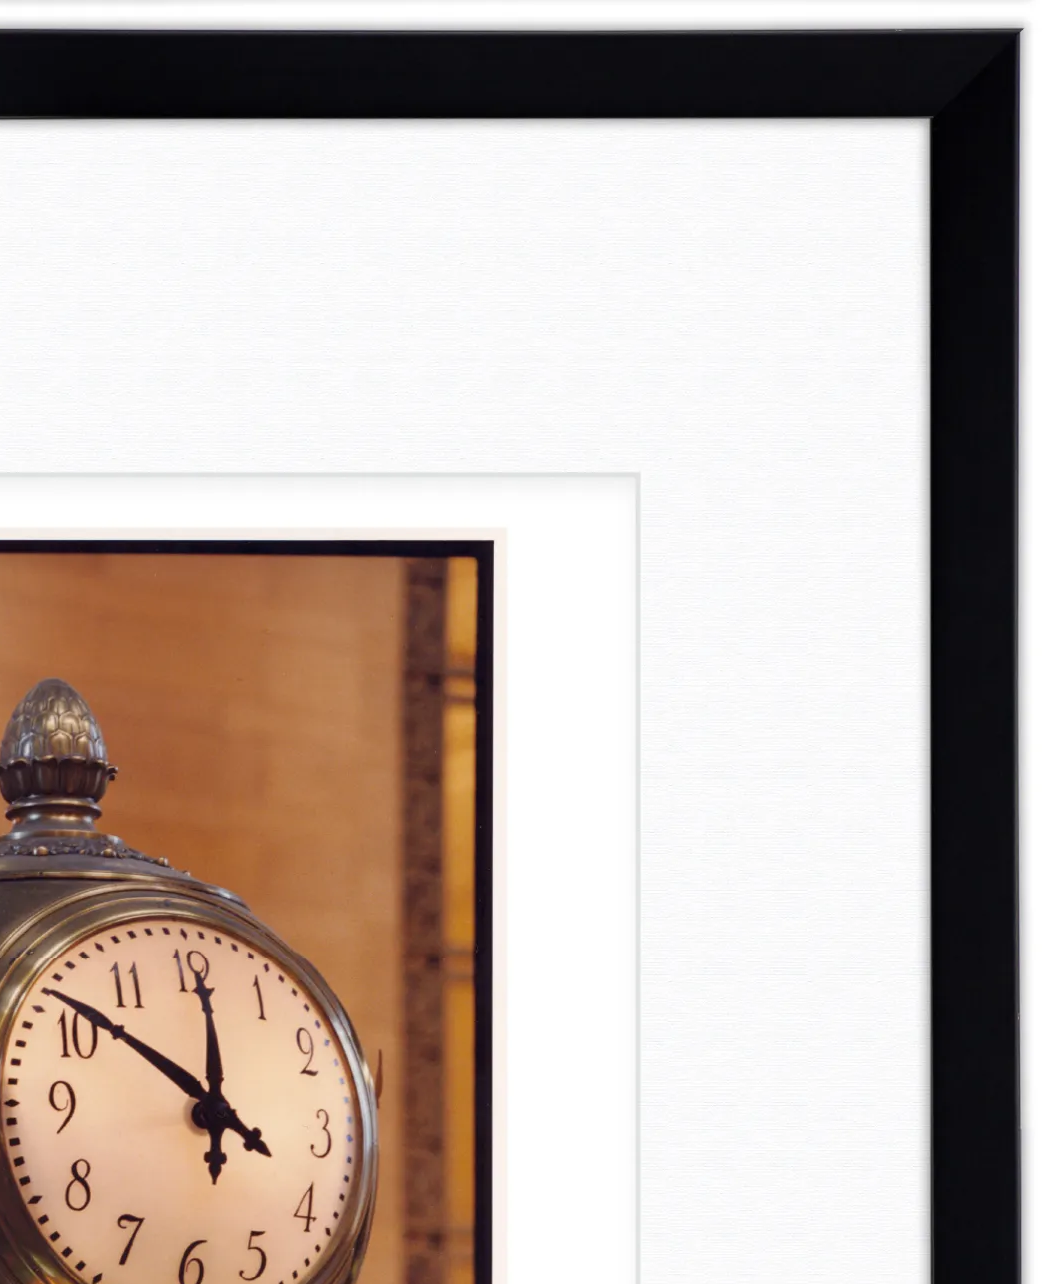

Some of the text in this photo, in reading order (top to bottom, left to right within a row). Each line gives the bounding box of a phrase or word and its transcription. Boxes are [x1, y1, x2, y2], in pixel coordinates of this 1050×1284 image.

[109, 961, 145, 1009] 11
[252, 975, 267, 1021] 1
[57, 1008, 98, 1060] 10
[296, 1027, 319, 1076] 2
[48, 1080, 76, 1134] 9
[310, 1109, 332, 1158] 3
[64, 1158, 91, 1211] 8
[293, 1181, 317, 1232] 4
[117, 1213, 145, 1266] 7
[238, 1230, 267, 1281] 5
